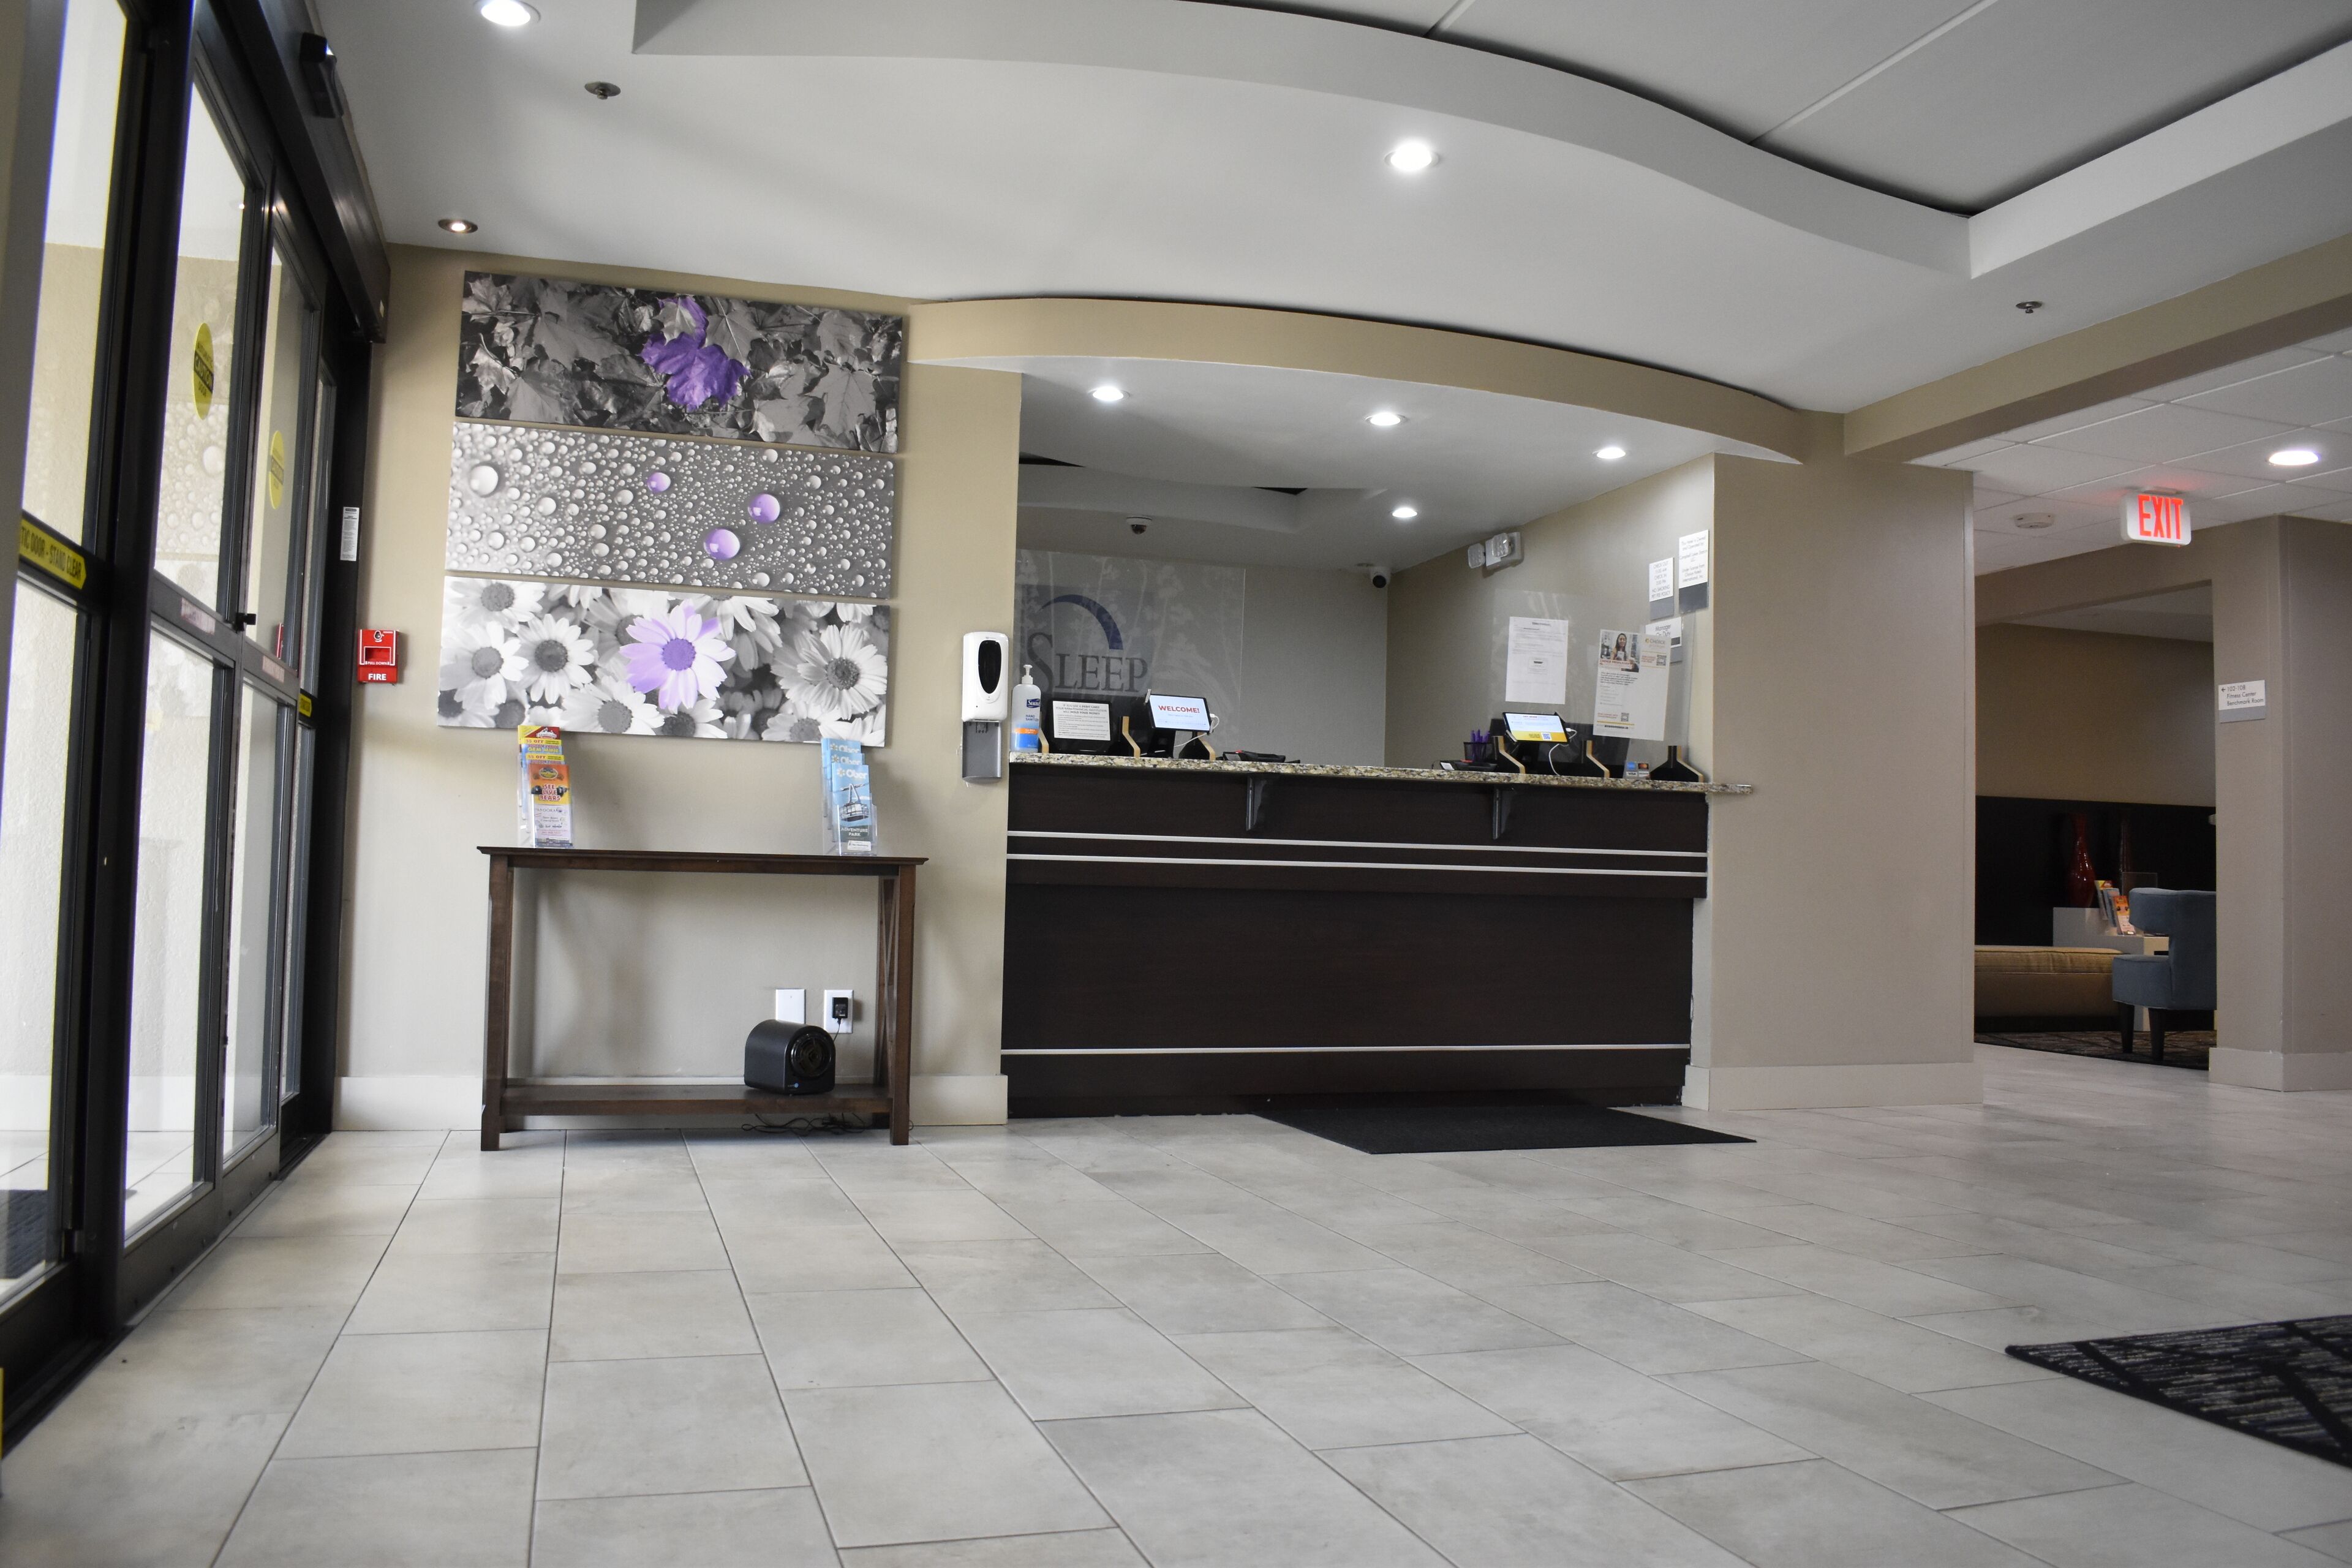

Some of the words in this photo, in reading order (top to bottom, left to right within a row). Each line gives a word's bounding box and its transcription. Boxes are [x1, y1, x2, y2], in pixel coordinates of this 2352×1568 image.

[195, 355, 214, 391] CAUTION
[2137, 494, 2183, 540] EXIT
[30, 532, 46, 559] DOOR
[50, 544, 66, 572] STAND
[66, 555, 82, 581] CLEAR
[1027, 632, 1147, 693] SLEEP
[1158, 705, 1200, 714] WELCOME!
[839, 745, 861, 753] Ober
[840, 756, 861, 765] Ober
[846, 769, 867, 778] Ober
